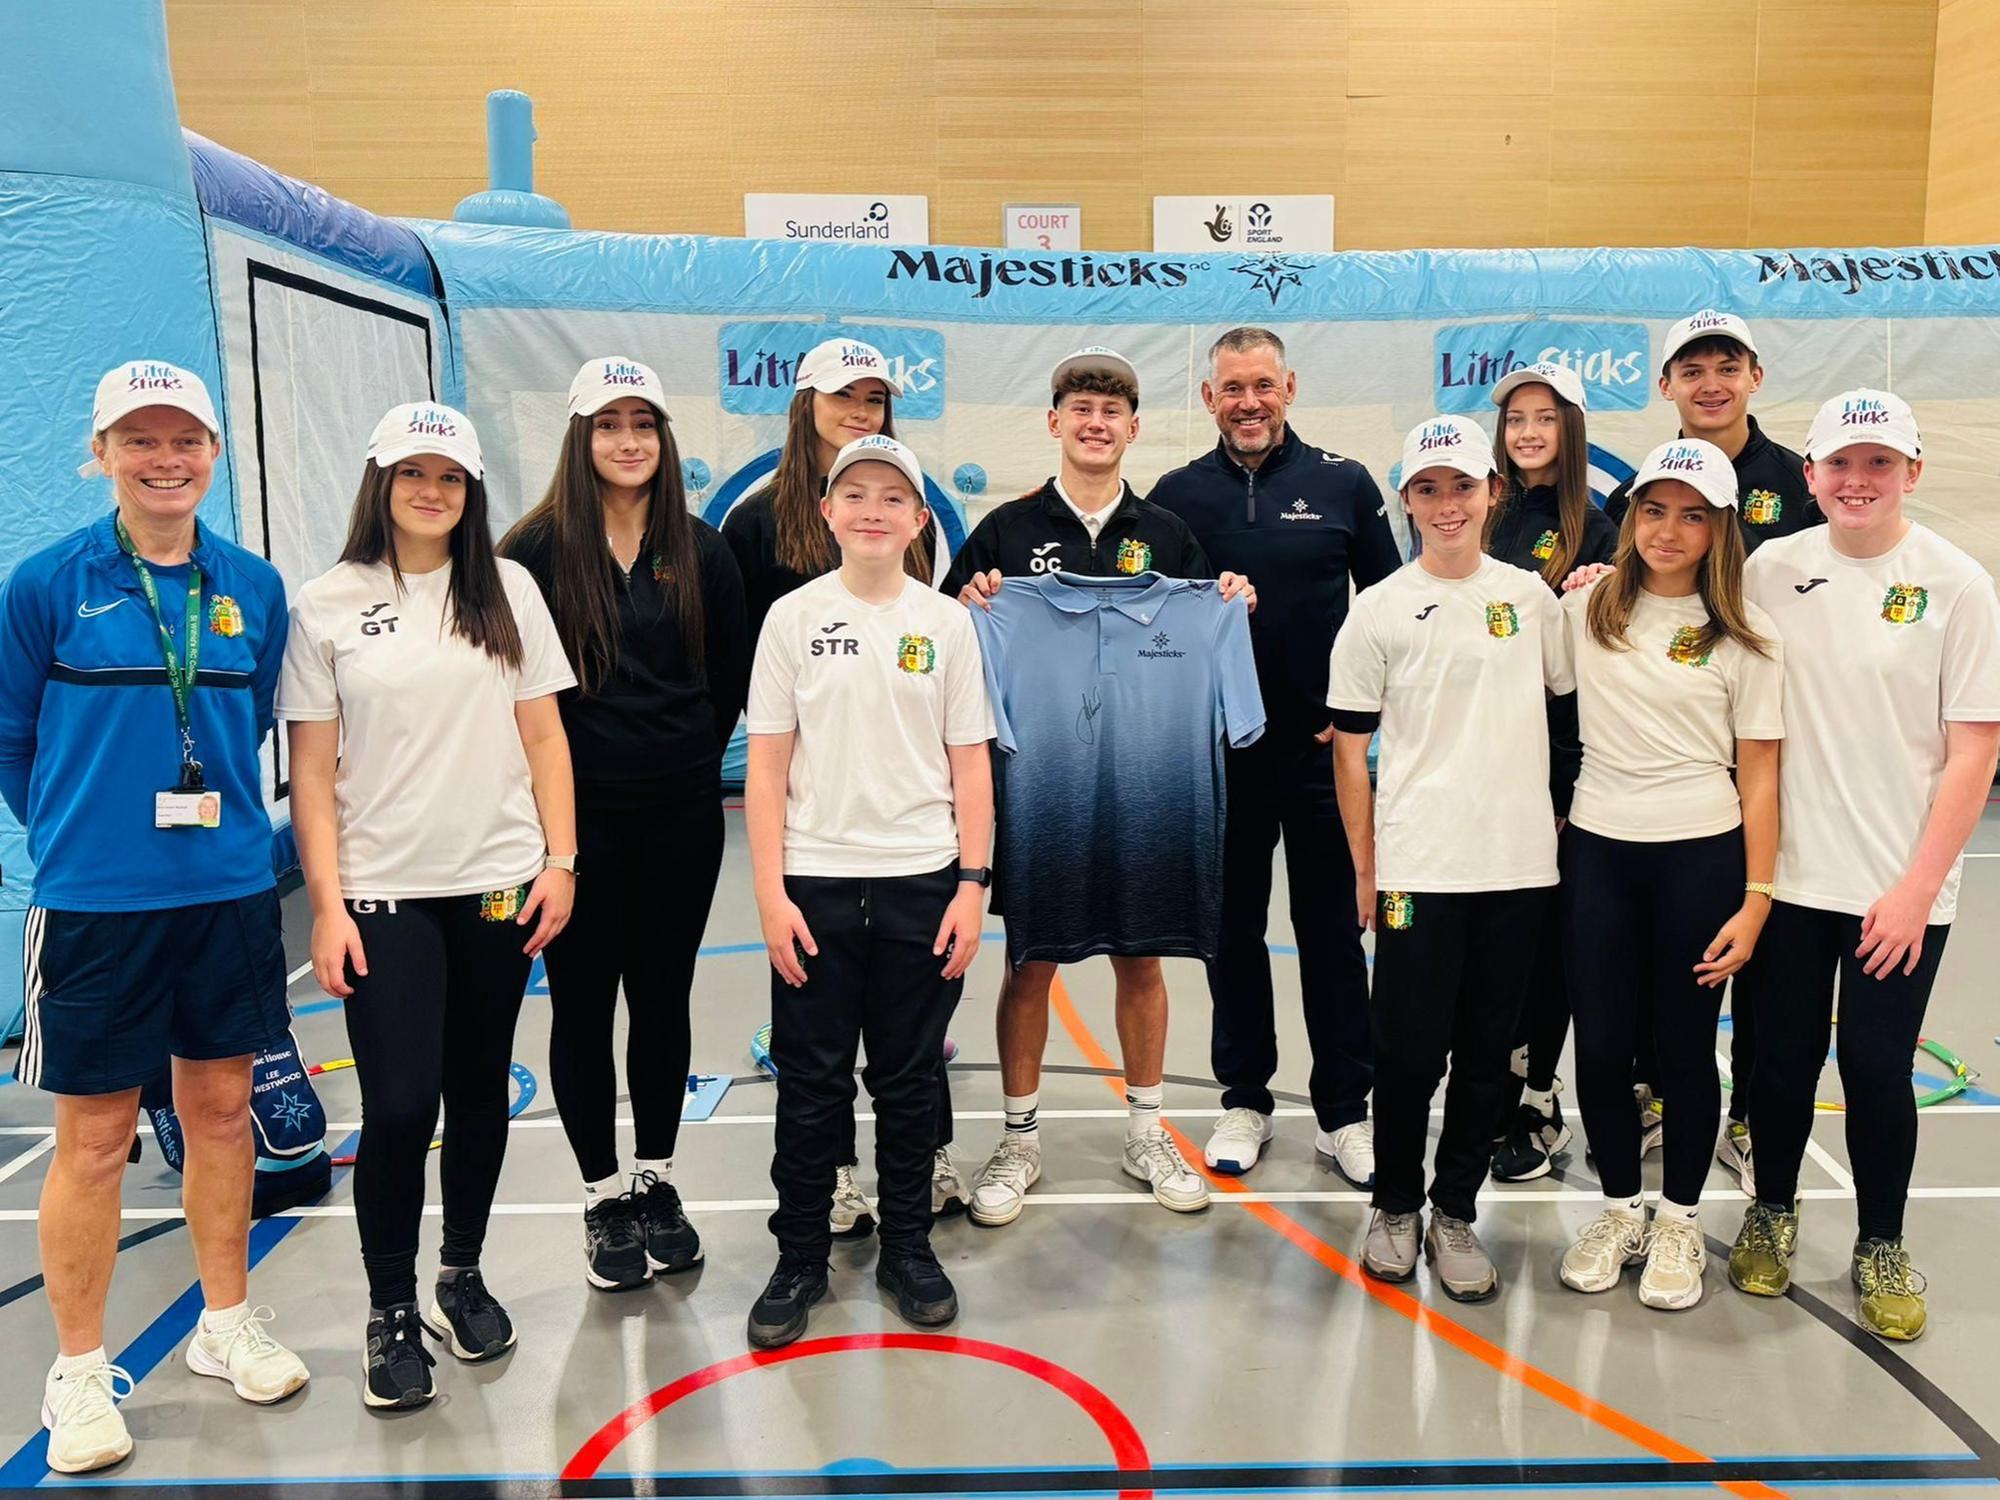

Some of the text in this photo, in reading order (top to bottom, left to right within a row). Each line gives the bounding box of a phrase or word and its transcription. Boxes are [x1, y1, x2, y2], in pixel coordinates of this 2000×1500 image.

[785, 219, 889, 239] Sunderland
[1018, 214, 1069, 229] COURT
[1037, 234, 1052, 251] 3
[887, 249, 1187, 298] Majesticks
[131, 364, 177, 379] Little
[605, 363, 641, 376] Little
[727, 349, 807, 388] Littl
[128, 377, 183, 392] Sticks
[1844, 399, 1885, 412] Little
[1840, 411, 1889, 427] Sticks
[407, 420, 457, 437] Sticks
[1418, 432, 1463, 453] Sticks
[1658, 458, 1704, 472] Sticks
[1030, 557, 1062, 573] OC
[361, 616, 399, 636] GT
[811, 638, 859, 656] STR
[1137, 650, 1184, 660] Majesticks
[265, 1050, 292, 1063] House
[253, 1071, 302, 1093] WESTWOOD
[265, 1069, 280, 1080] LEE
[154, 1108, 177, 1162] esticks
